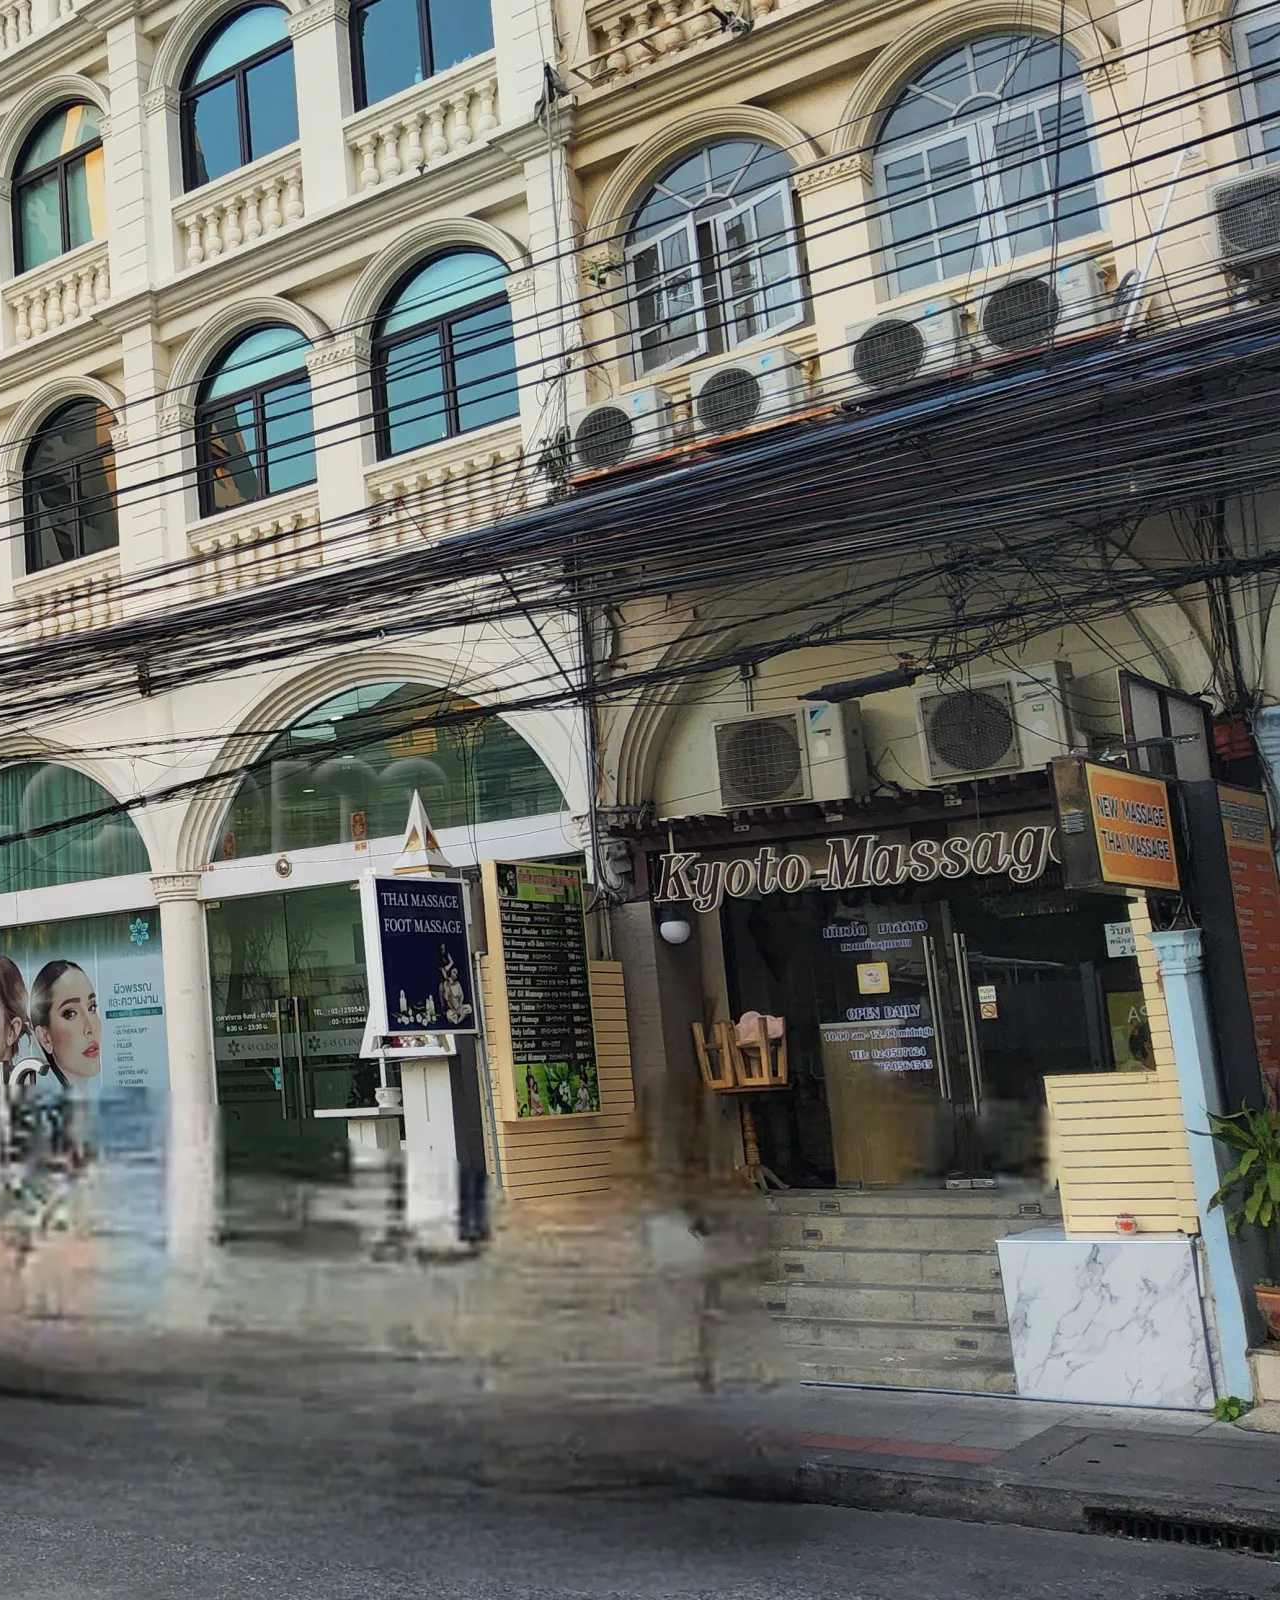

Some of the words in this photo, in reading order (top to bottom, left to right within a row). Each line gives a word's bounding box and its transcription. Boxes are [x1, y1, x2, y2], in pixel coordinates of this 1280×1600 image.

[1095, 793, 1119, 818] NEW
[1120, 799, 1166, 829] MASSAGE
[1100, 828, 1125, 855] THAI
[1126, 832, 1171, 862] MASSAGE
[653, 846, 810, 913] Kyoto
[822, 826, 1061, 891] Massag
[380, 892, 409, 906] THAI
[410, 894, 459, 909] MASSAGE
[383, 918, 412, 932] FOOT
[414, 919, 462, 934] MASSAGE
[113, 982, 152, 995] ผิวพรรณ
[846, 1006, 880, 1020] OPEN
[883, 1004, 921, 1019] DAILY
